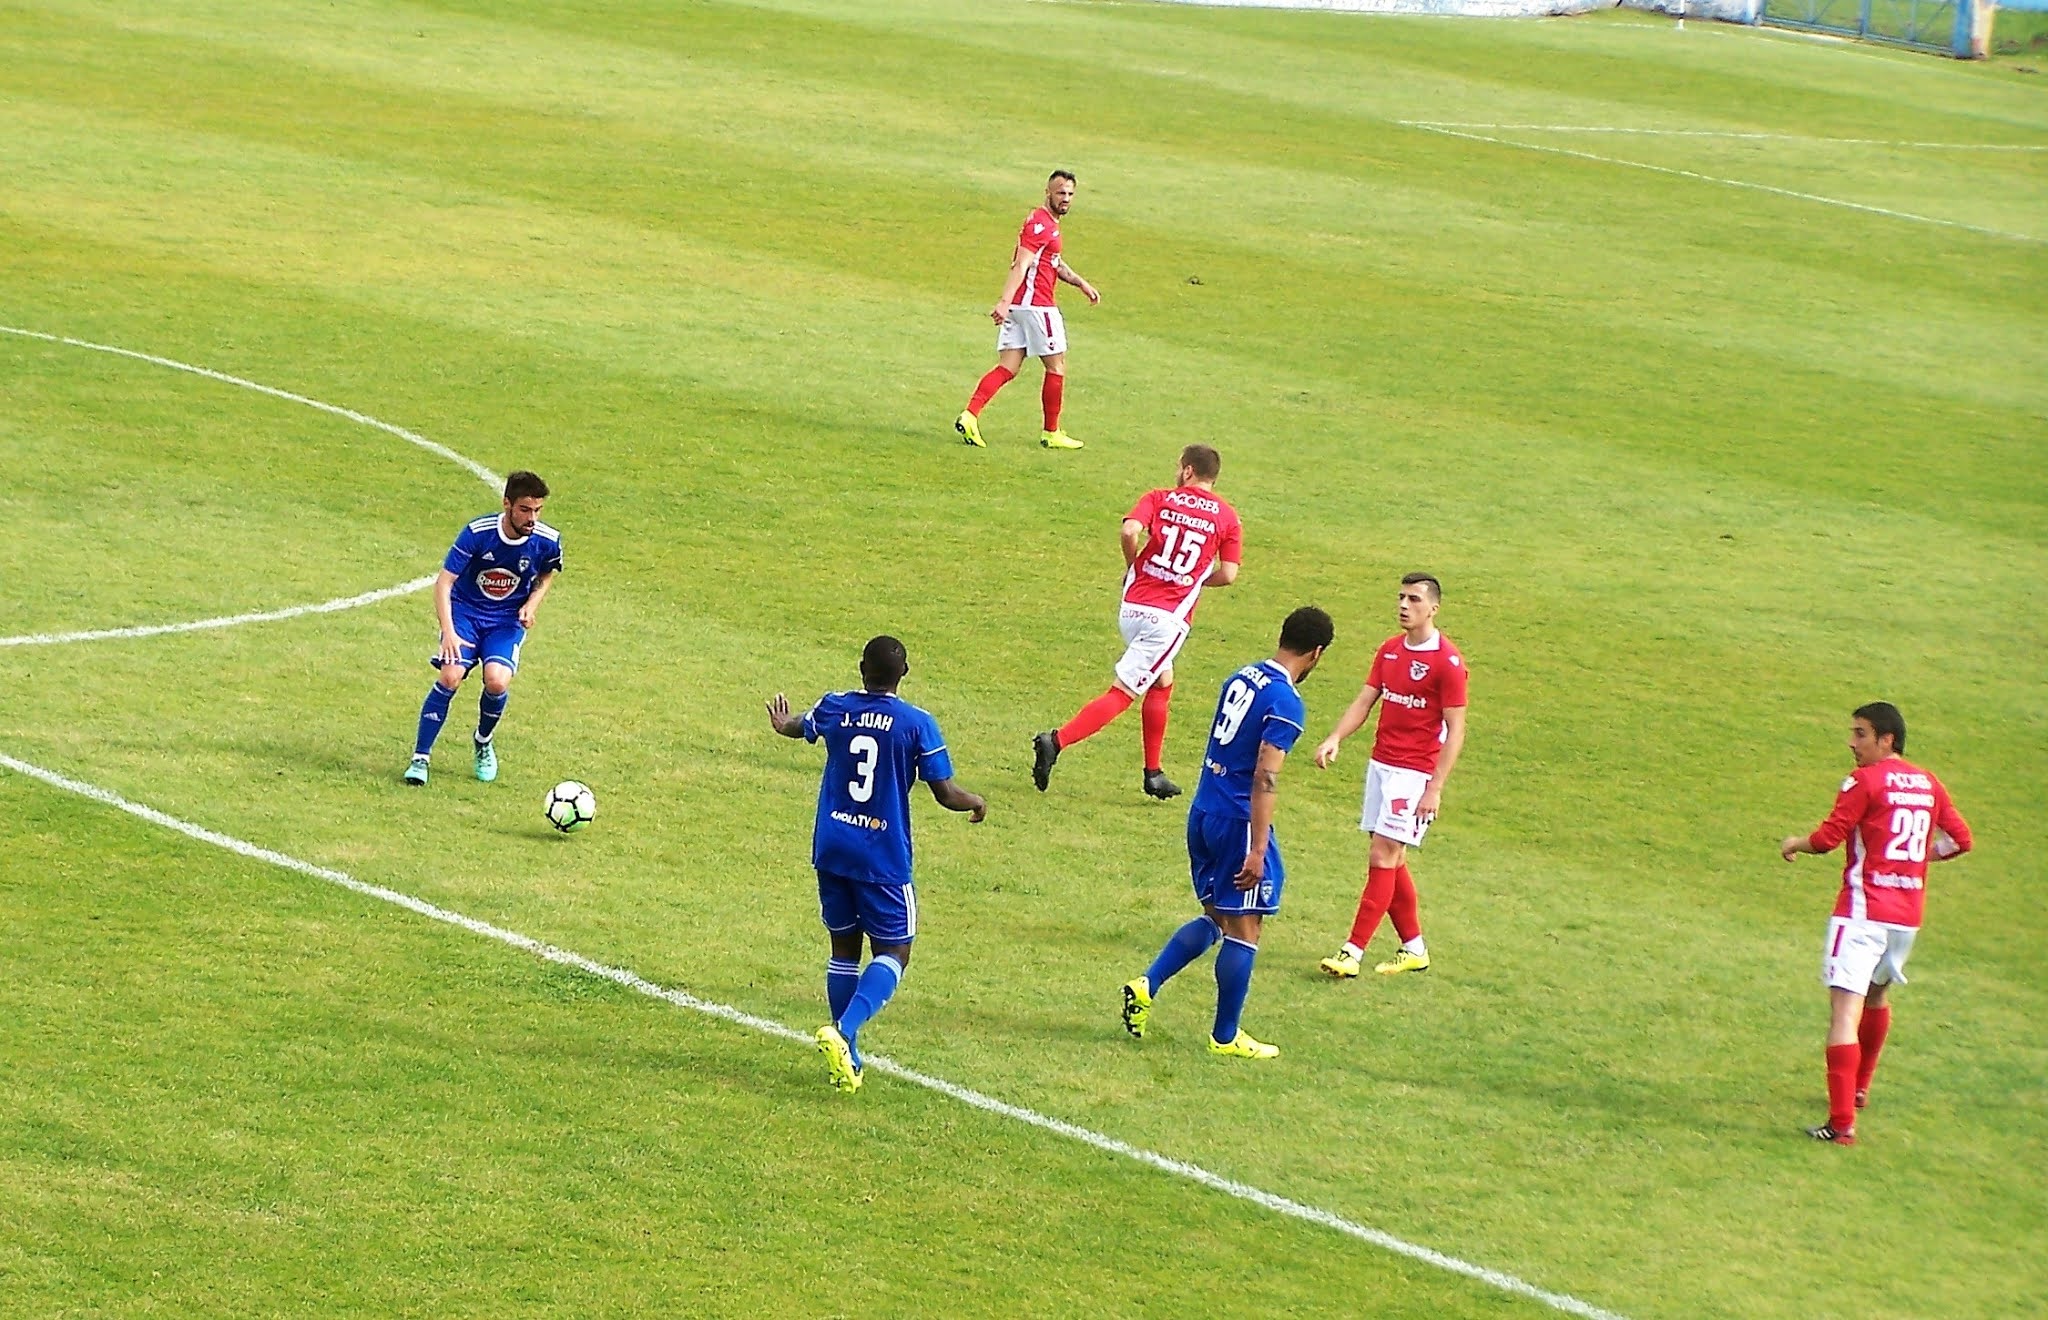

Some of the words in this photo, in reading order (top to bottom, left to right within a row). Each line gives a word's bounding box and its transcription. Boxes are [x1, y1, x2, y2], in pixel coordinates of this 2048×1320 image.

[1150, 524, 1207, 575] 15
[840, 712, 853, 728] J.
[856, 712, 894, 732] JUAH
[848, 734, 879, 803] 3
[1884, 808, 1931, 862] 28
